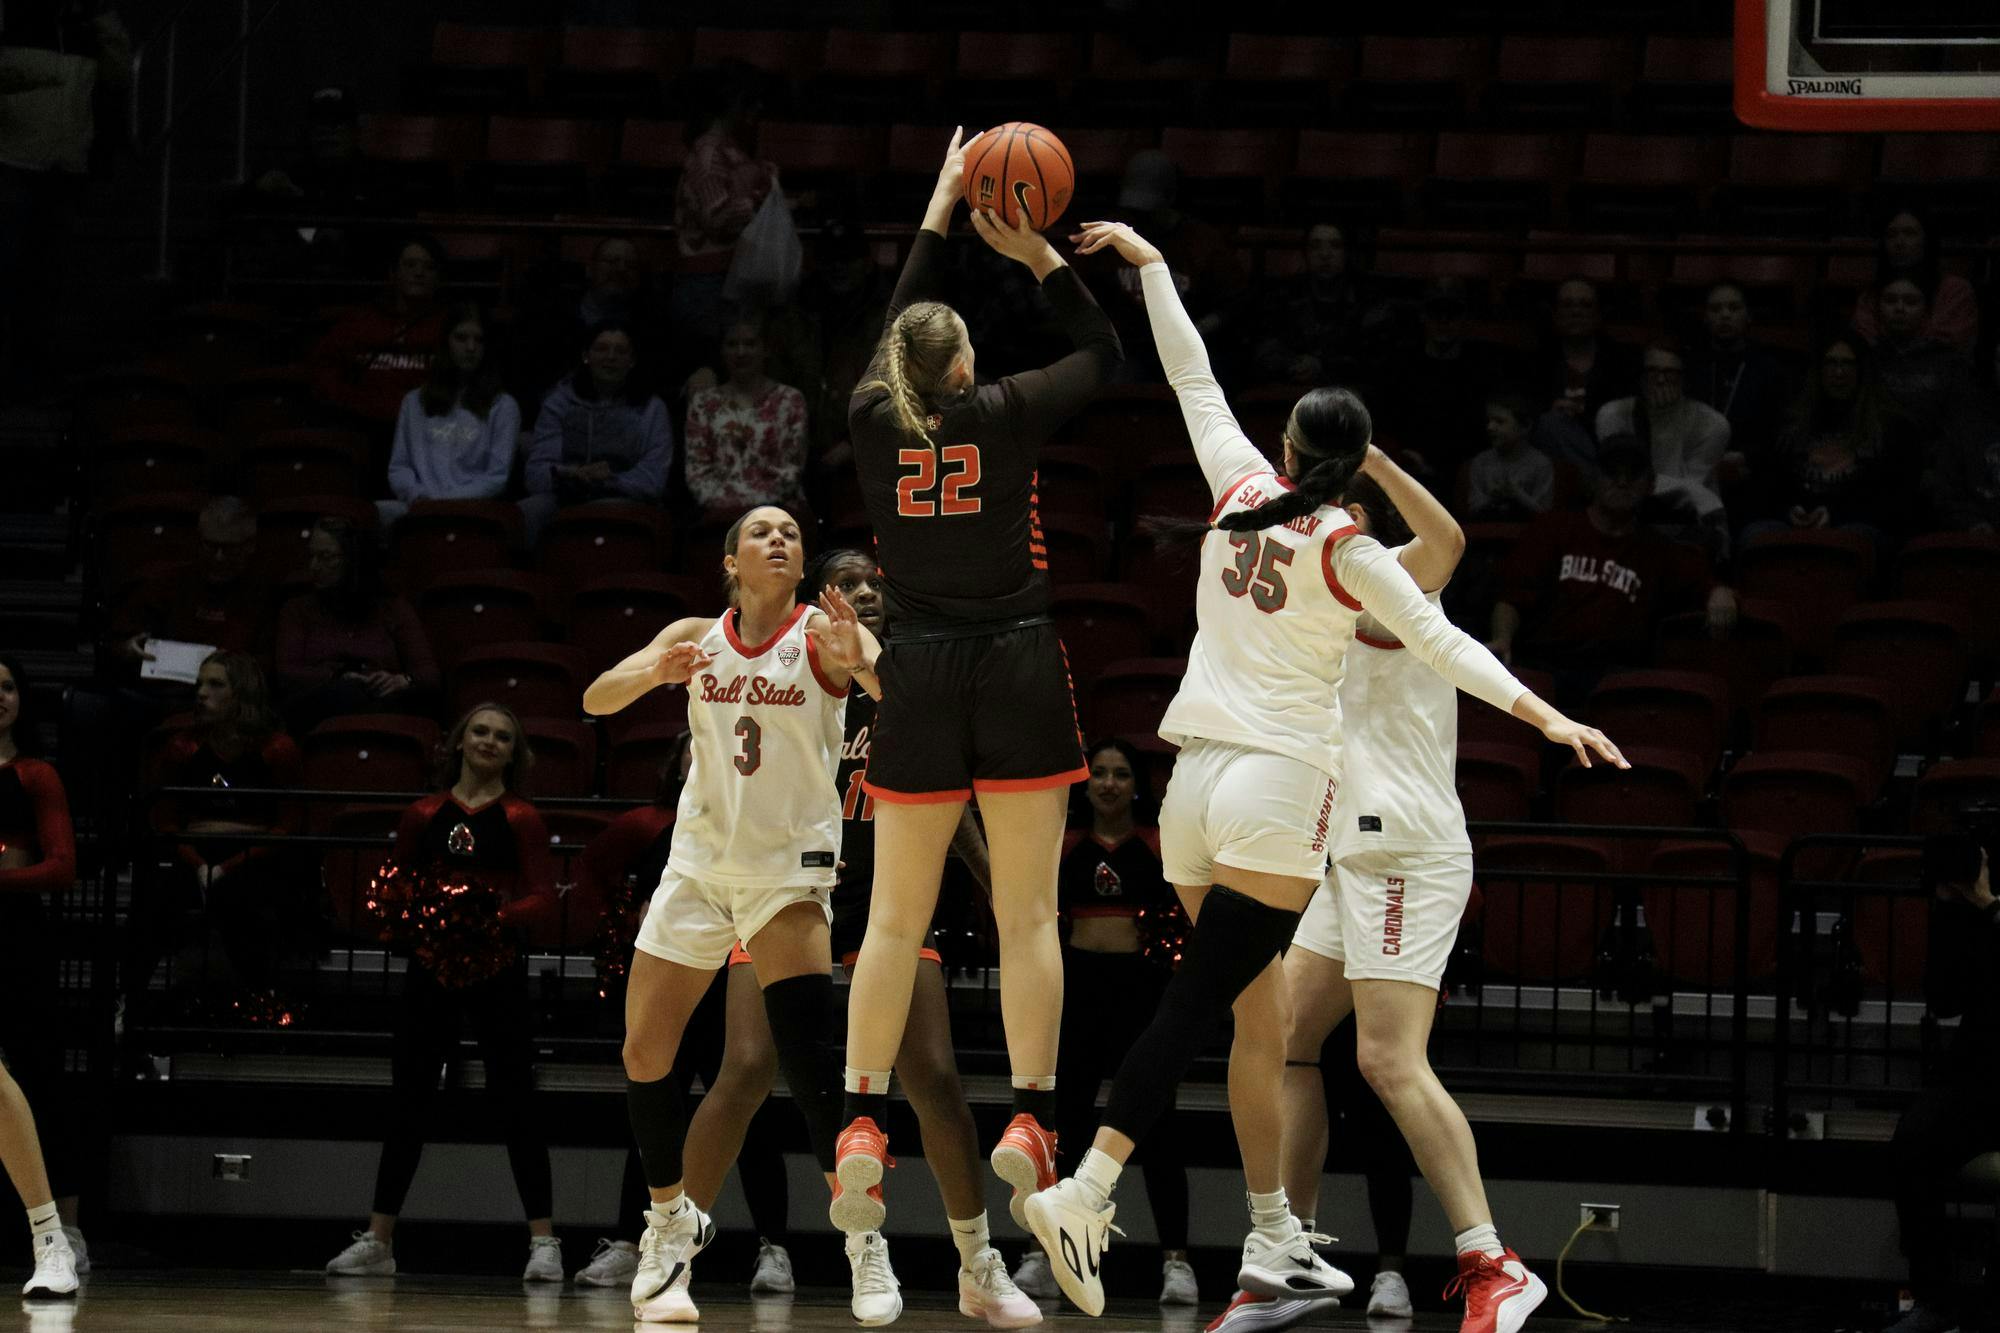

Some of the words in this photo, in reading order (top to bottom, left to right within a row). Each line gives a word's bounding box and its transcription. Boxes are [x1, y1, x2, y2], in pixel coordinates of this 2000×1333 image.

[1787, 79, 1862, 96] SPALDING
[896, 444, 982, 517] 22
[1221, 530, 1296, 615] 35
[1558, 553, 1599, 583] BALL
[700, 674, 747, 704] Ball
[746, 676, 806, 706] State
[734, 716, 761, 776] 3
[1312, 778, 1336, 853] CARDINAS
[1382, 877, 1405, 956] CARDINALS
